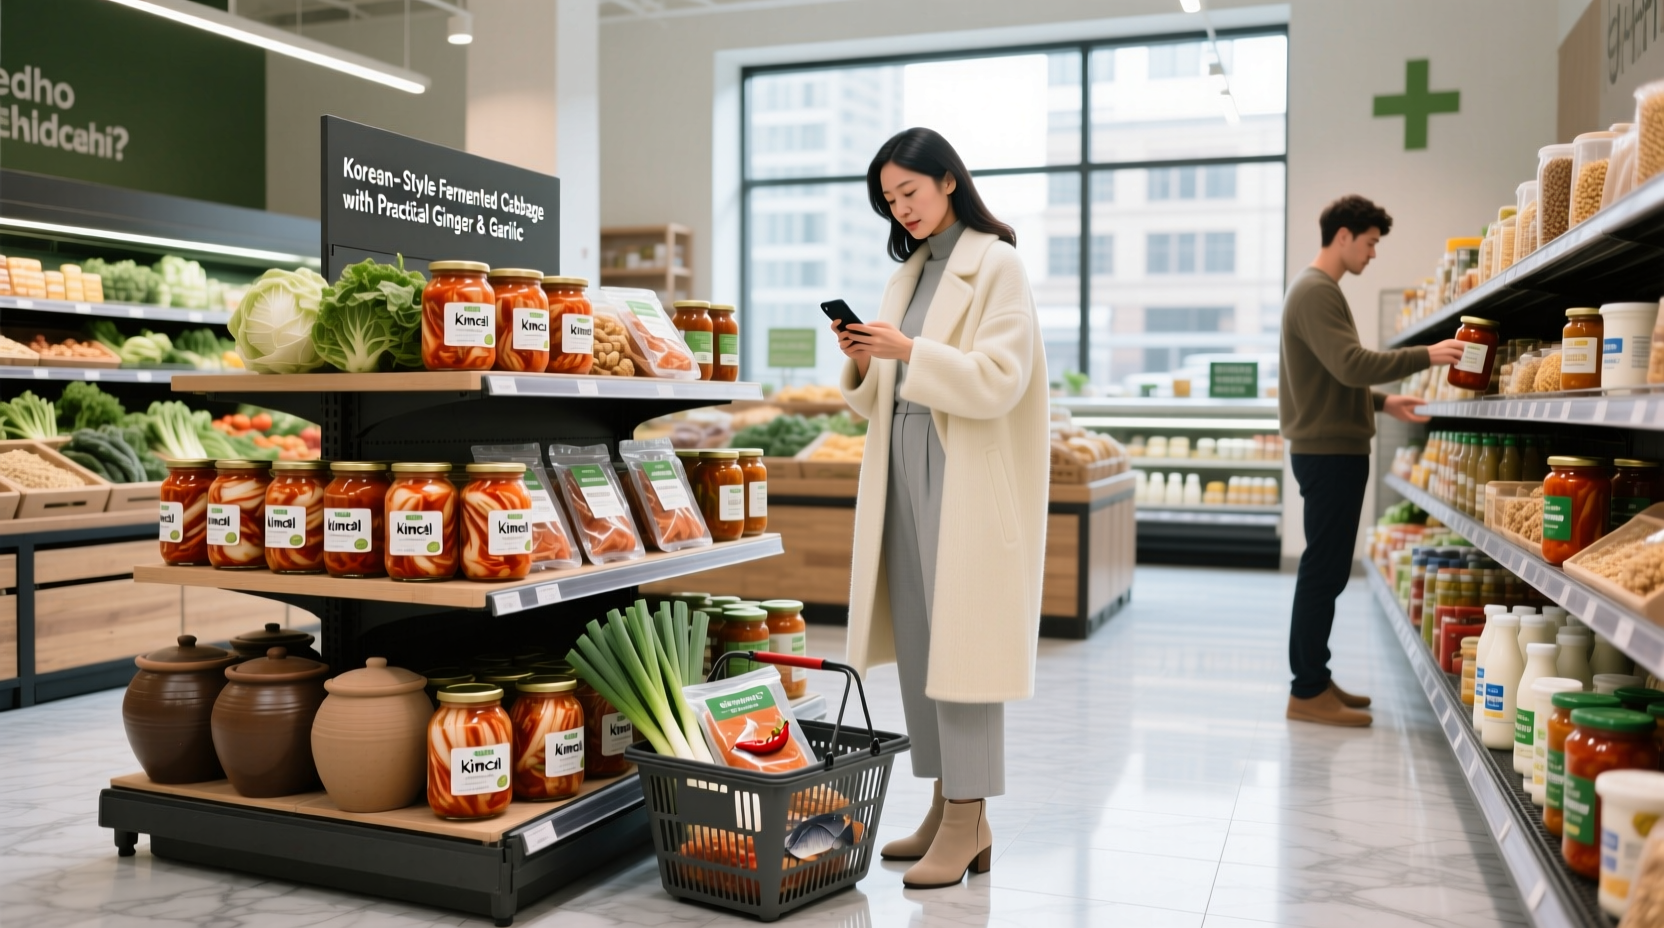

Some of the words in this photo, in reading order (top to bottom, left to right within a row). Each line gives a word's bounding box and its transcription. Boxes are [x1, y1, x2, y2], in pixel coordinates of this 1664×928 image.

[342, 188, 374, 214] with
[432, 204, 474, 235] Ginger
[476, 214, 487, 236] &
